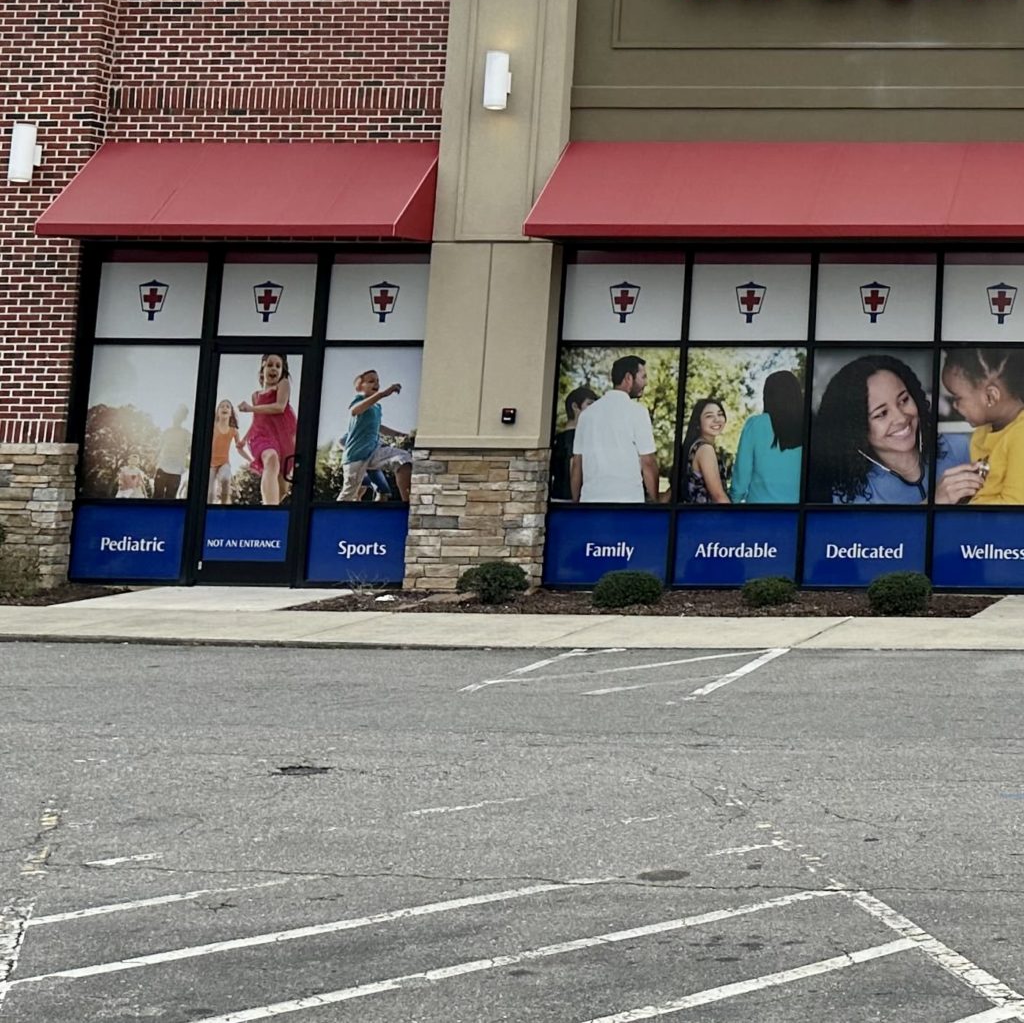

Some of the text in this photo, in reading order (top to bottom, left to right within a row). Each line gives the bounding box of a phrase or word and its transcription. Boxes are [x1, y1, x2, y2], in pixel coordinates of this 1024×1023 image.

[100, 536, 165, 553] Pediatric
[207, 539, 281, 549] NOT AN ENTRANCE
[338, 540, 387, 559] Sports
[585, 541, 634, 561] Family
[695, 542, 777, 559] Affordable
[826, 542, 904, 559] Dedicated
